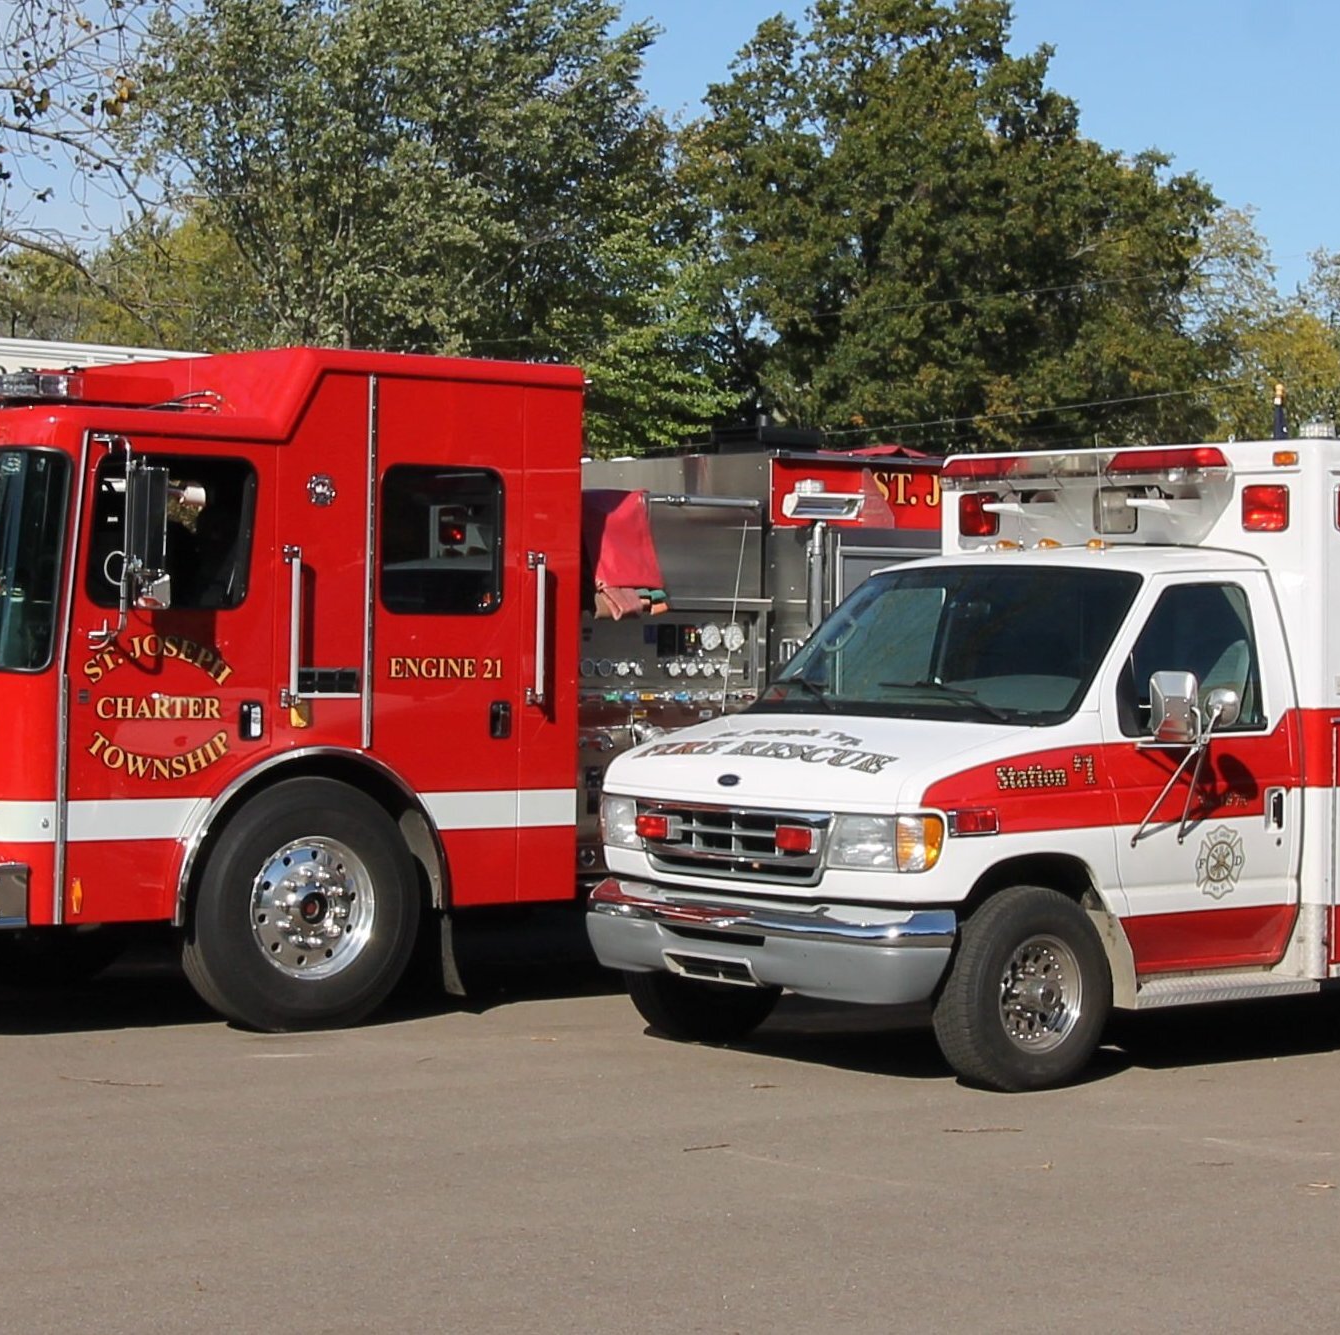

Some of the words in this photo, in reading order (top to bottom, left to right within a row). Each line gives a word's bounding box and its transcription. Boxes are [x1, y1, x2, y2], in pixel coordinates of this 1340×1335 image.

[83, 646, 124, 684] ST.
[129, 634, 233, 686] JOSEPH
[390, 657, 477, 678] ENGINE
[482, 658, 502, 679] 21
[96, 697, 221, 719] CHARTER
[88, 731, 229, 780] TOWNSHIP
[721, 741, 900, 774] RESCUE
[996, 765, 1067, 790] Station
[1073, 754, 1096, 785] #1
